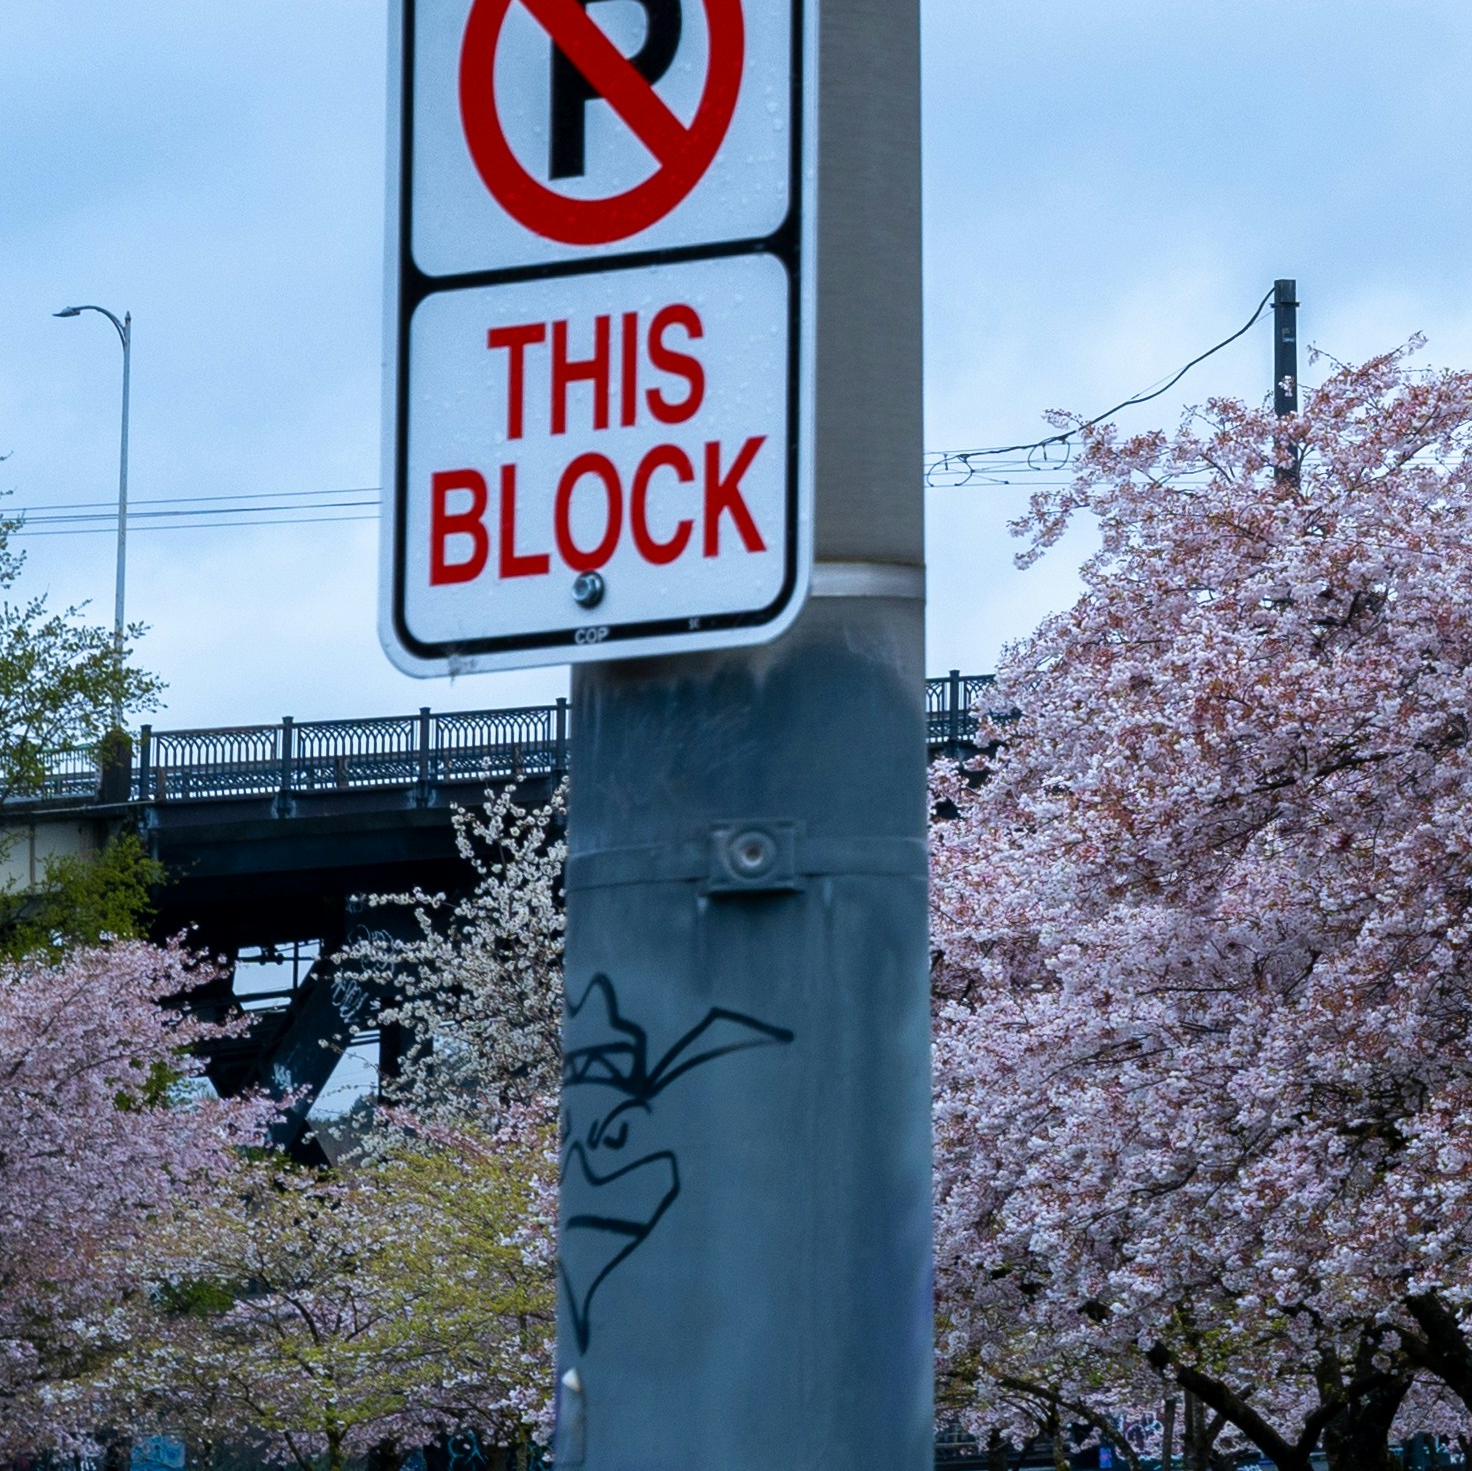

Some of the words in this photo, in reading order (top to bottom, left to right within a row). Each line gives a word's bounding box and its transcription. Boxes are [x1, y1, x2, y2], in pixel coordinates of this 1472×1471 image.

[488, 304, 705, 440] THIS
[430, 435, 767, 586] BLOCK
[575, 627, 609, 644] COP
